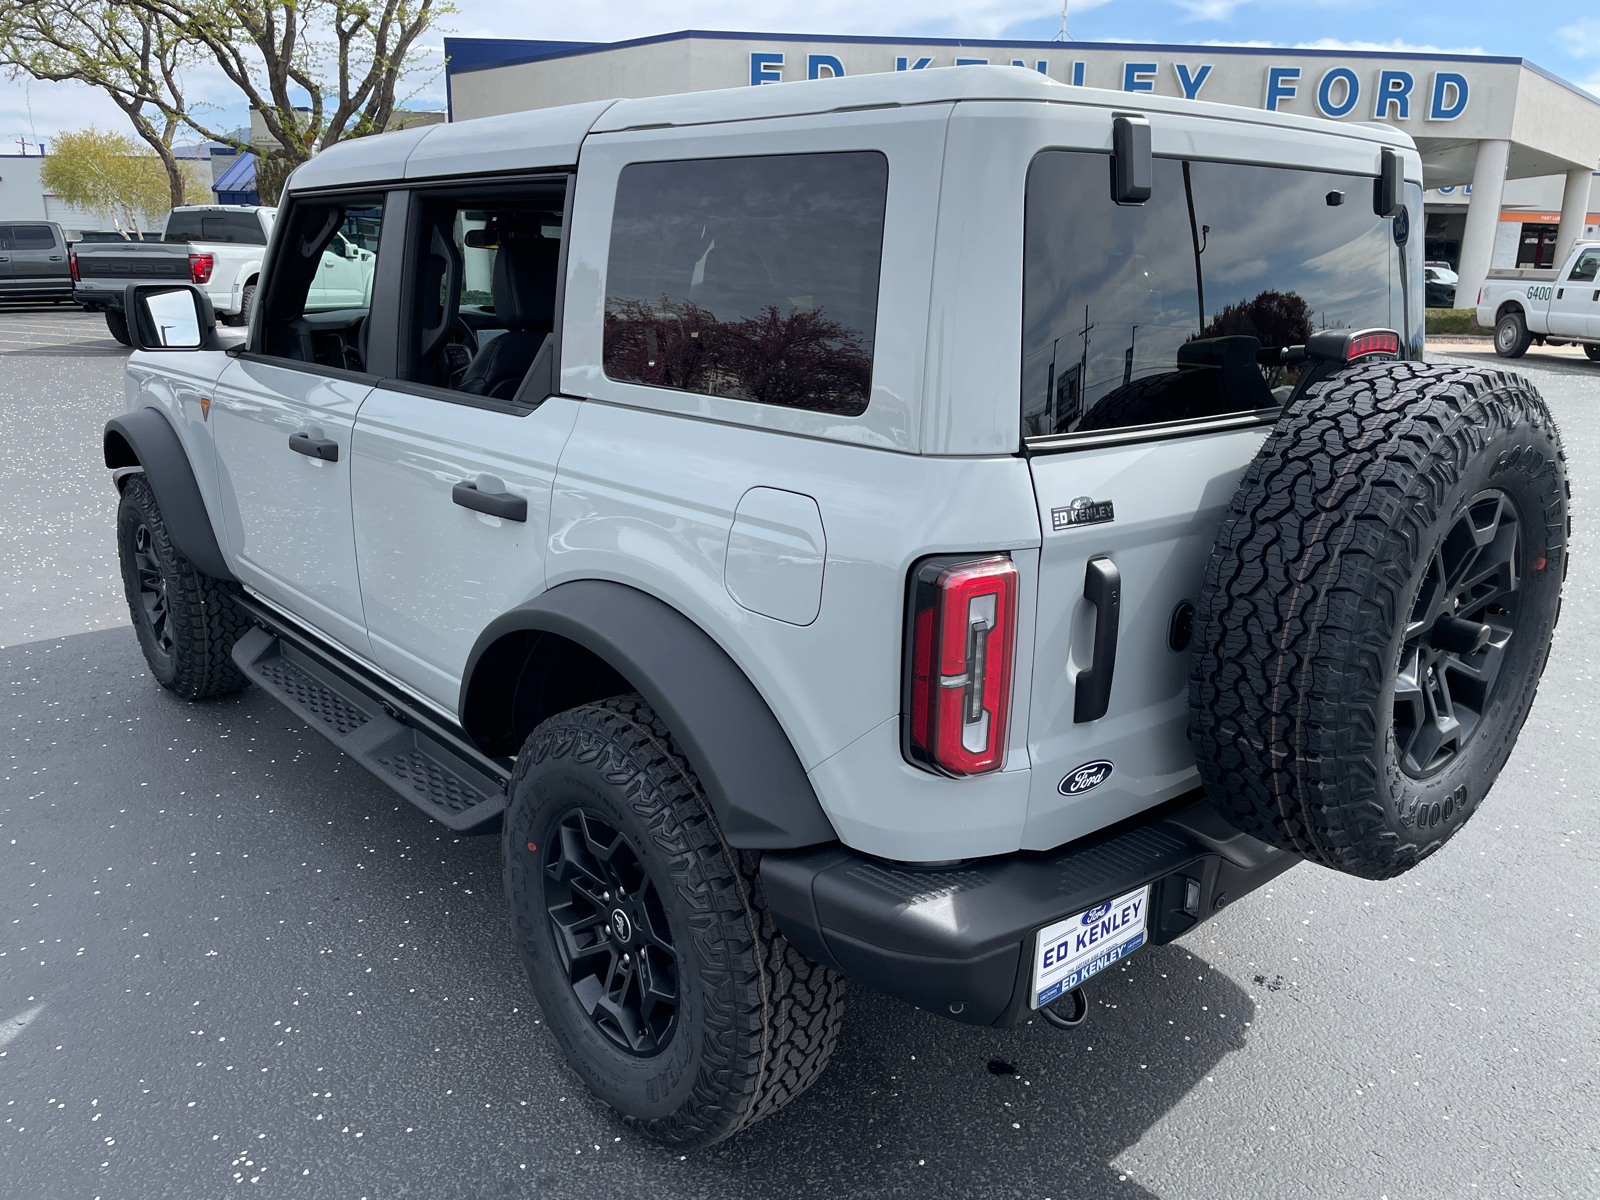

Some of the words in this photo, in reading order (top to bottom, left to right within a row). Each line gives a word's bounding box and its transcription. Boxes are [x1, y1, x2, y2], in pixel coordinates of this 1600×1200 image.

[1265, 65, 1470, 121] FORD
[89, 263, 176, 273] FORD
[1527, 286, 1551, 301] G400
[1053, 511, 1068, 525] ED
[1071, 505, 1112, 522] KENLEY
[1068, 765, 1107, 793] Ford
[1085, 904, 1108, 924] Ford
[1043, 940, 1069, 969] ED
[1076, 898, 1142, 953] KENLEY
[1061, 973, 1078, 992] ED
[1081, 945, 1124, 981] KENLEY
